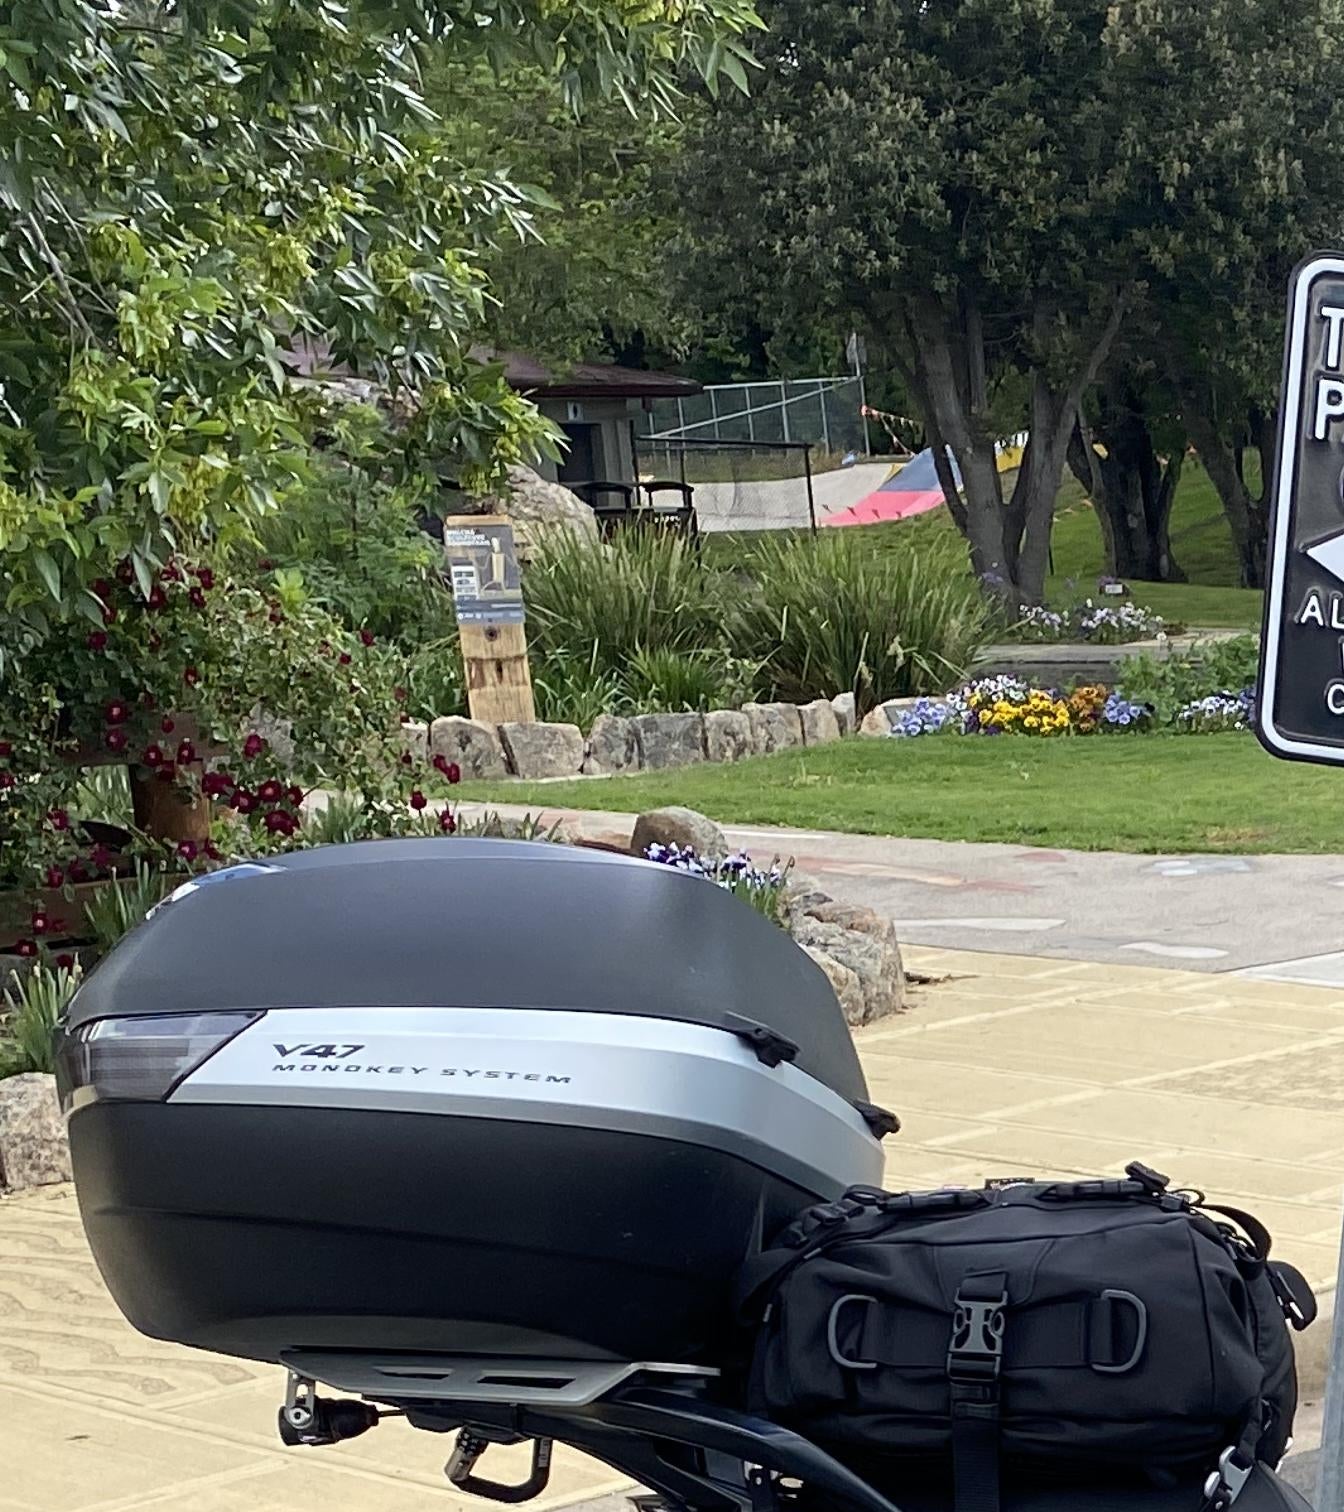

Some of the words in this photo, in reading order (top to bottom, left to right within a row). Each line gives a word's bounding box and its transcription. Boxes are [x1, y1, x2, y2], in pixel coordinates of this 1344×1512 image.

[272, 1044, 365, 1059] V47
[272, 1064, 428, 1075] MONOKEY
[439, 1068, 572, 1084] SYSTEM
